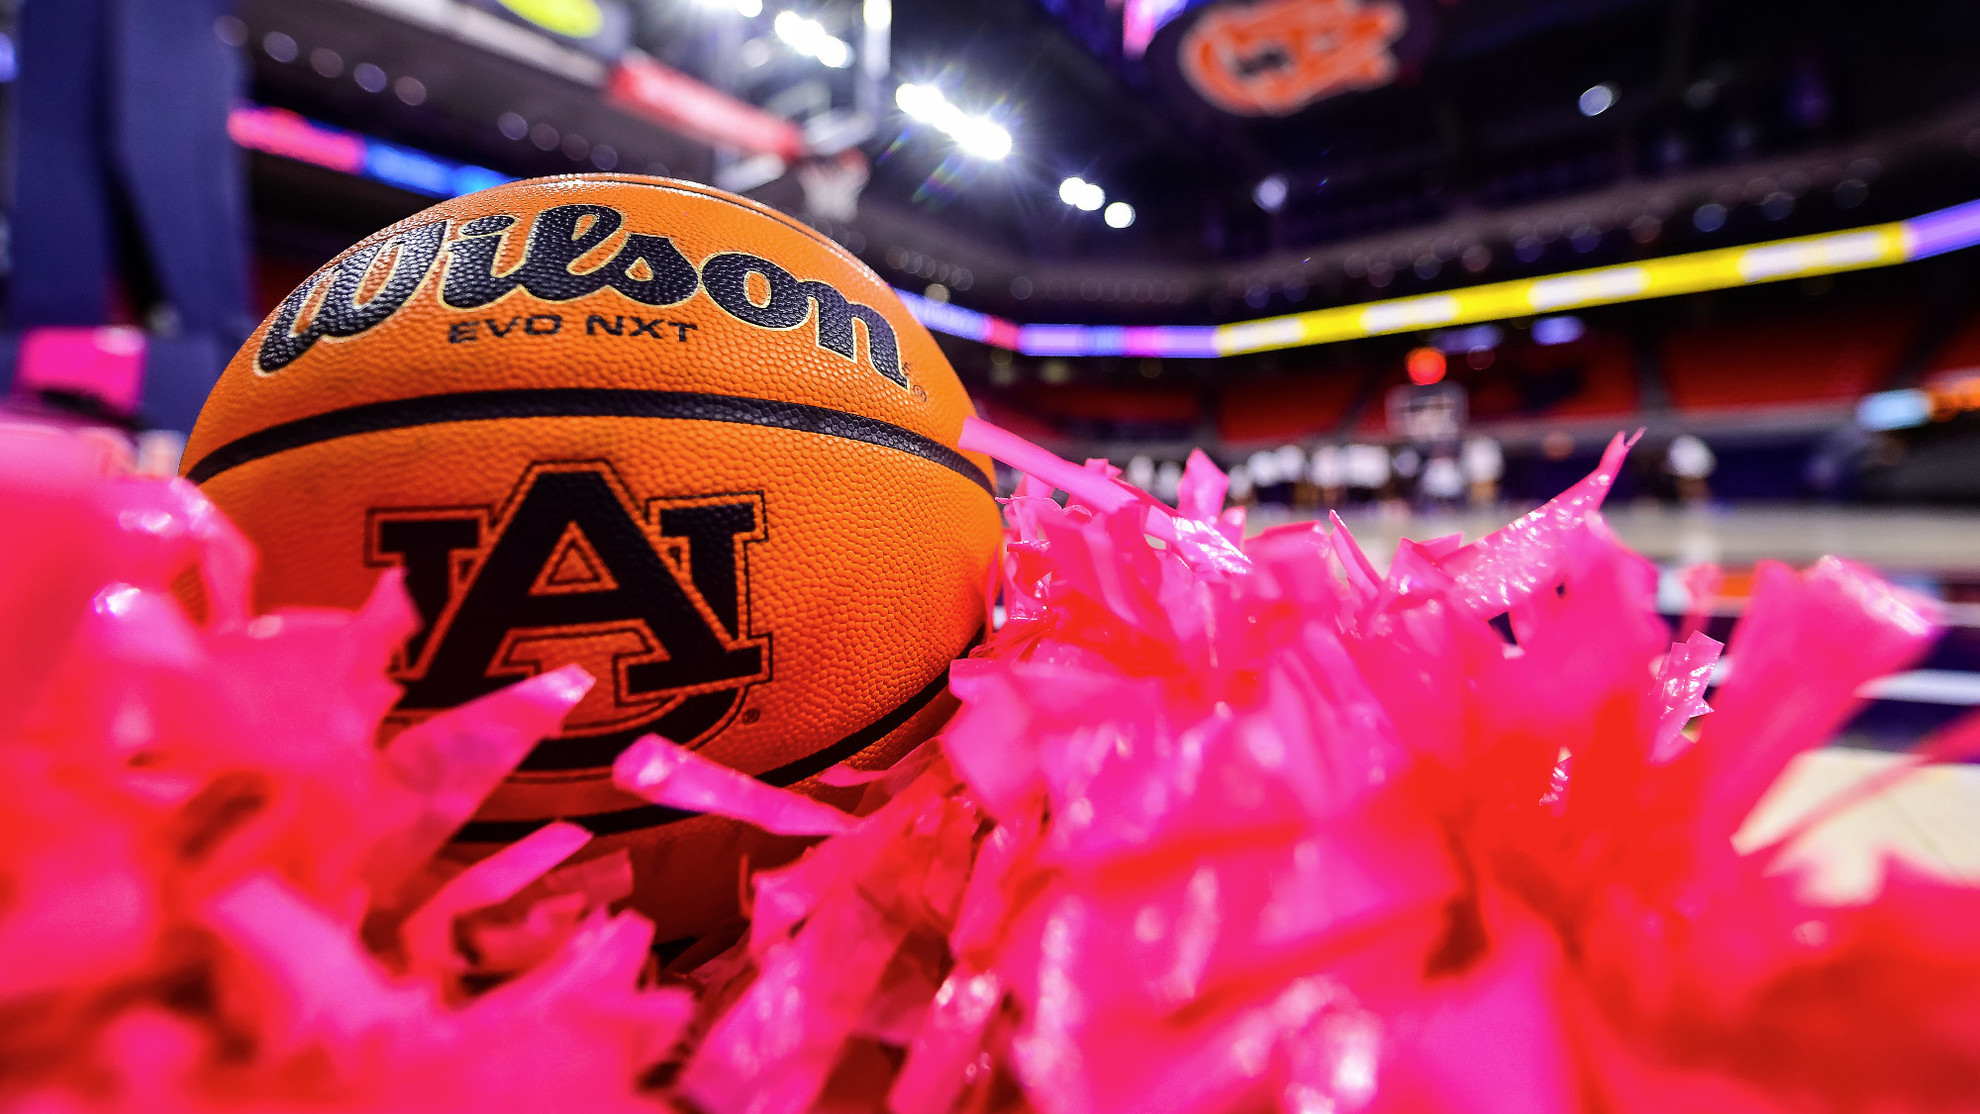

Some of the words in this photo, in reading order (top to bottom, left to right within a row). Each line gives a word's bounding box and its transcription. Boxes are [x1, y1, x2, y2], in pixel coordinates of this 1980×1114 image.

[253, 203, 911, 391] Wilson
[448, 314, 562, 344] EVO
[585, 315, 698, 343] NXT
